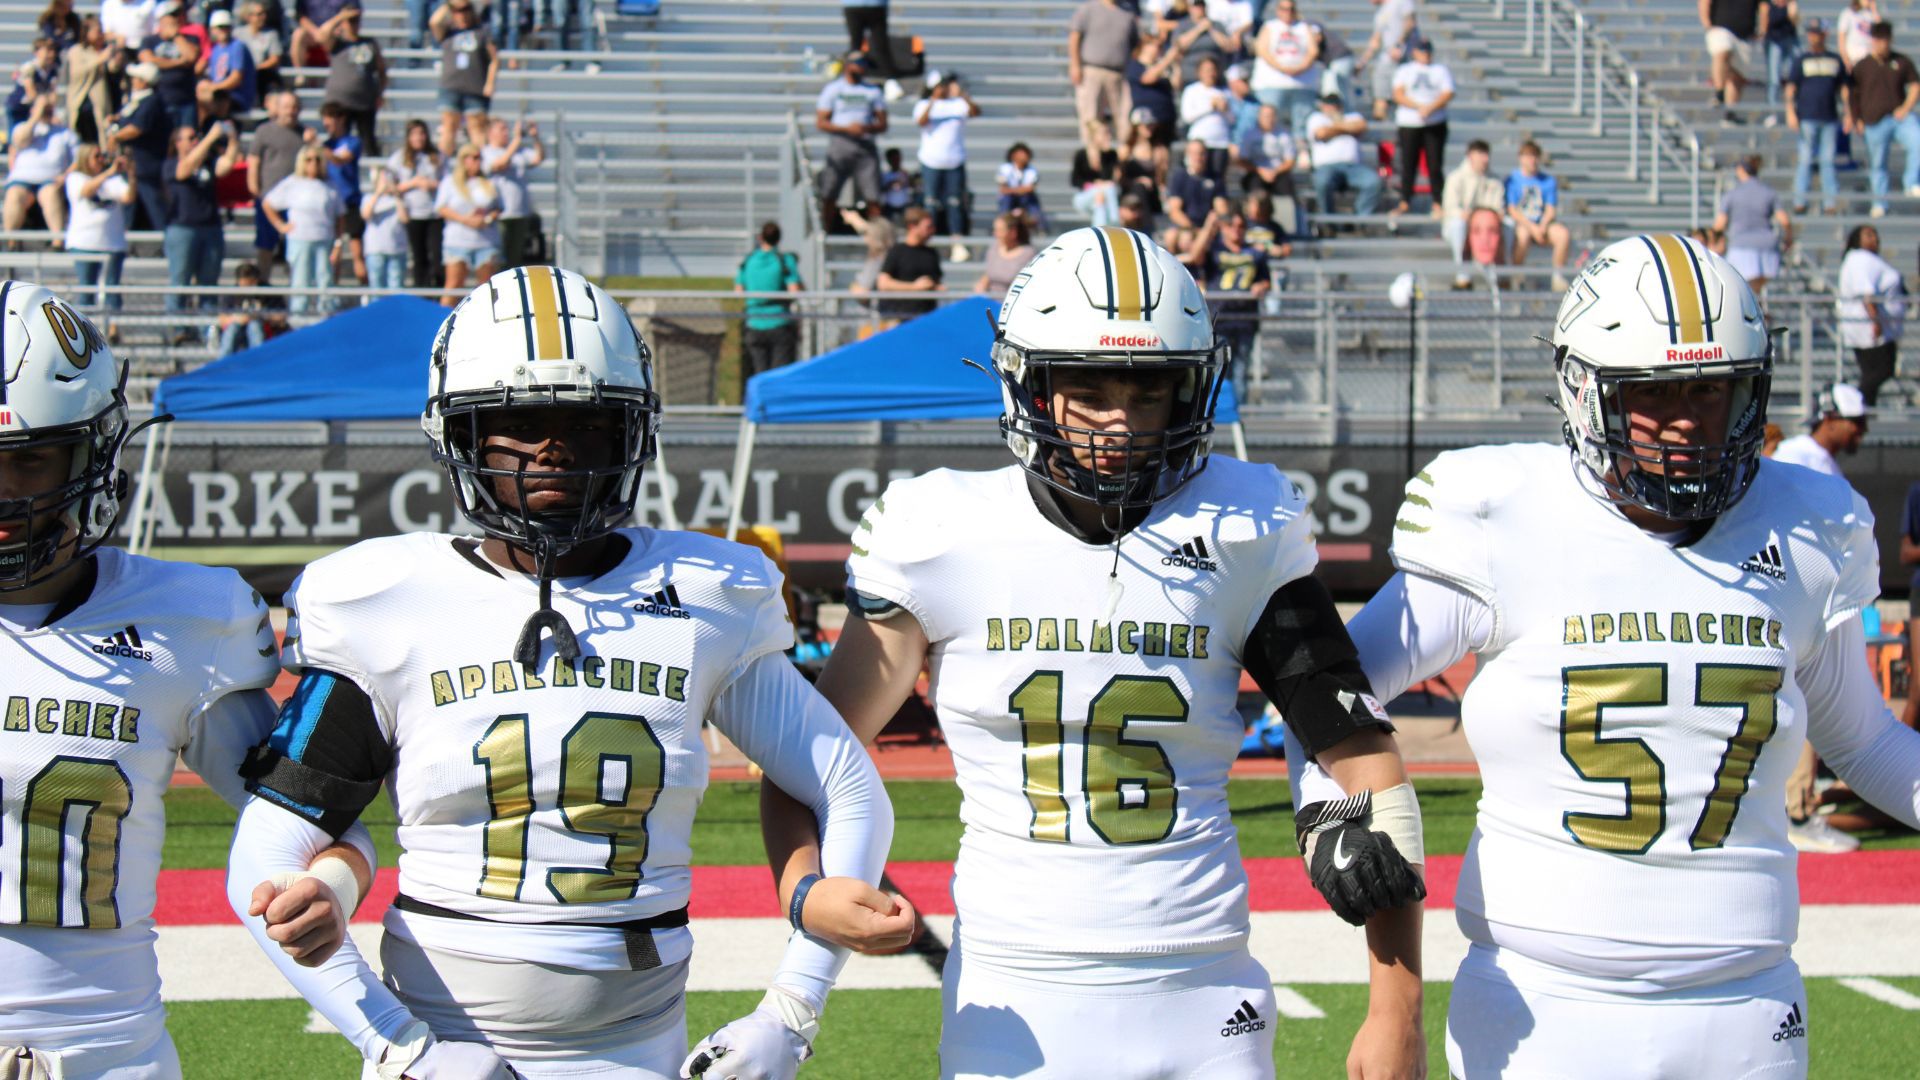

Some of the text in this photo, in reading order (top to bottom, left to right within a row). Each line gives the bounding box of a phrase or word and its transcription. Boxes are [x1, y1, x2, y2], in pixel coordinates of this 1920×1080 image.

[1099, 334, 1160, 347] Riddell
[1666, 346, 1723, 362] Riddell
[118, 470, 361, 538] ARKE
[389, 469, 800, 536] CRAL
[0, 553, 24, 566] dell
[1161, 554, 1217, 572] adidas
[1740, 560, 1786, 581] adidas
[633, 601, 691, 620] adidas
[987, 617, 1210, 659] APALACHEE
[1563, 611, 1785, 650] APALACHEE
[91, 642, 153, 662] adidas
[430, 656, 689, 707] APALACHEE
[3, 695, 141, 743] ACHEE
[1009, 669, 1190, 845] 16
[1560, 662, 1786, 855] 57
[472, 711, 666, 903] 19
[0, 755, 134, 929] 0
[1220, 1020, 1266, 1037] adidas
[1772, 1025, 1805, 1042] adida
